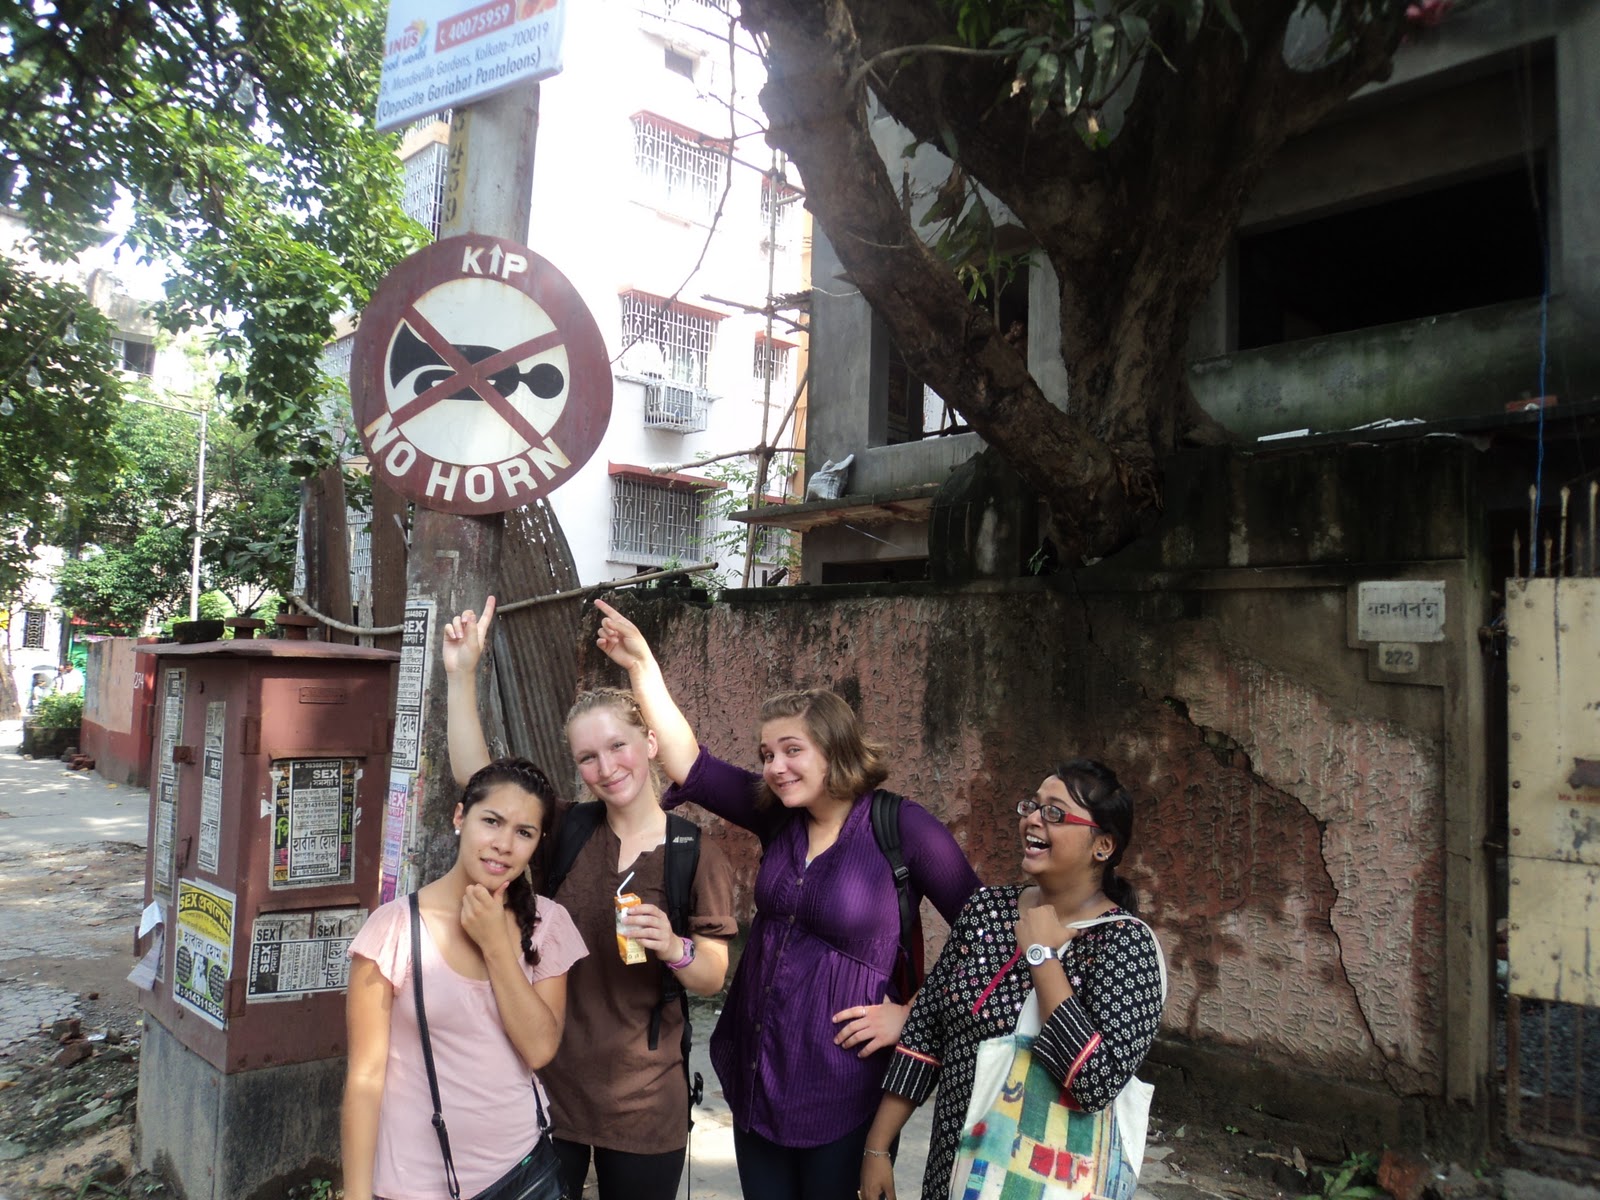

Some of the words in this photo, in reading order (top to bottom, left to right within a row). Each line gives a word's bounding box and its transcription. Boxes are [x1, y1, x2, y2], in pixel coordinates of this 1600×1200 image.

[449, 5, 511, 42] 40075959
[427, 72, 473, 101] Gariahat
[475, 47, 542, 85] Pantaloons)
[363, 411, 417, 477] NO
[425, 436, 572, 502] HORN
[312, 769, 339, 779] SEX
[180, 893, 198, 911] SEX
[256, 928, 276, 942] SEX
[317, 924, 336, 937] SEX
[259, 945, 272, 974] SEX
